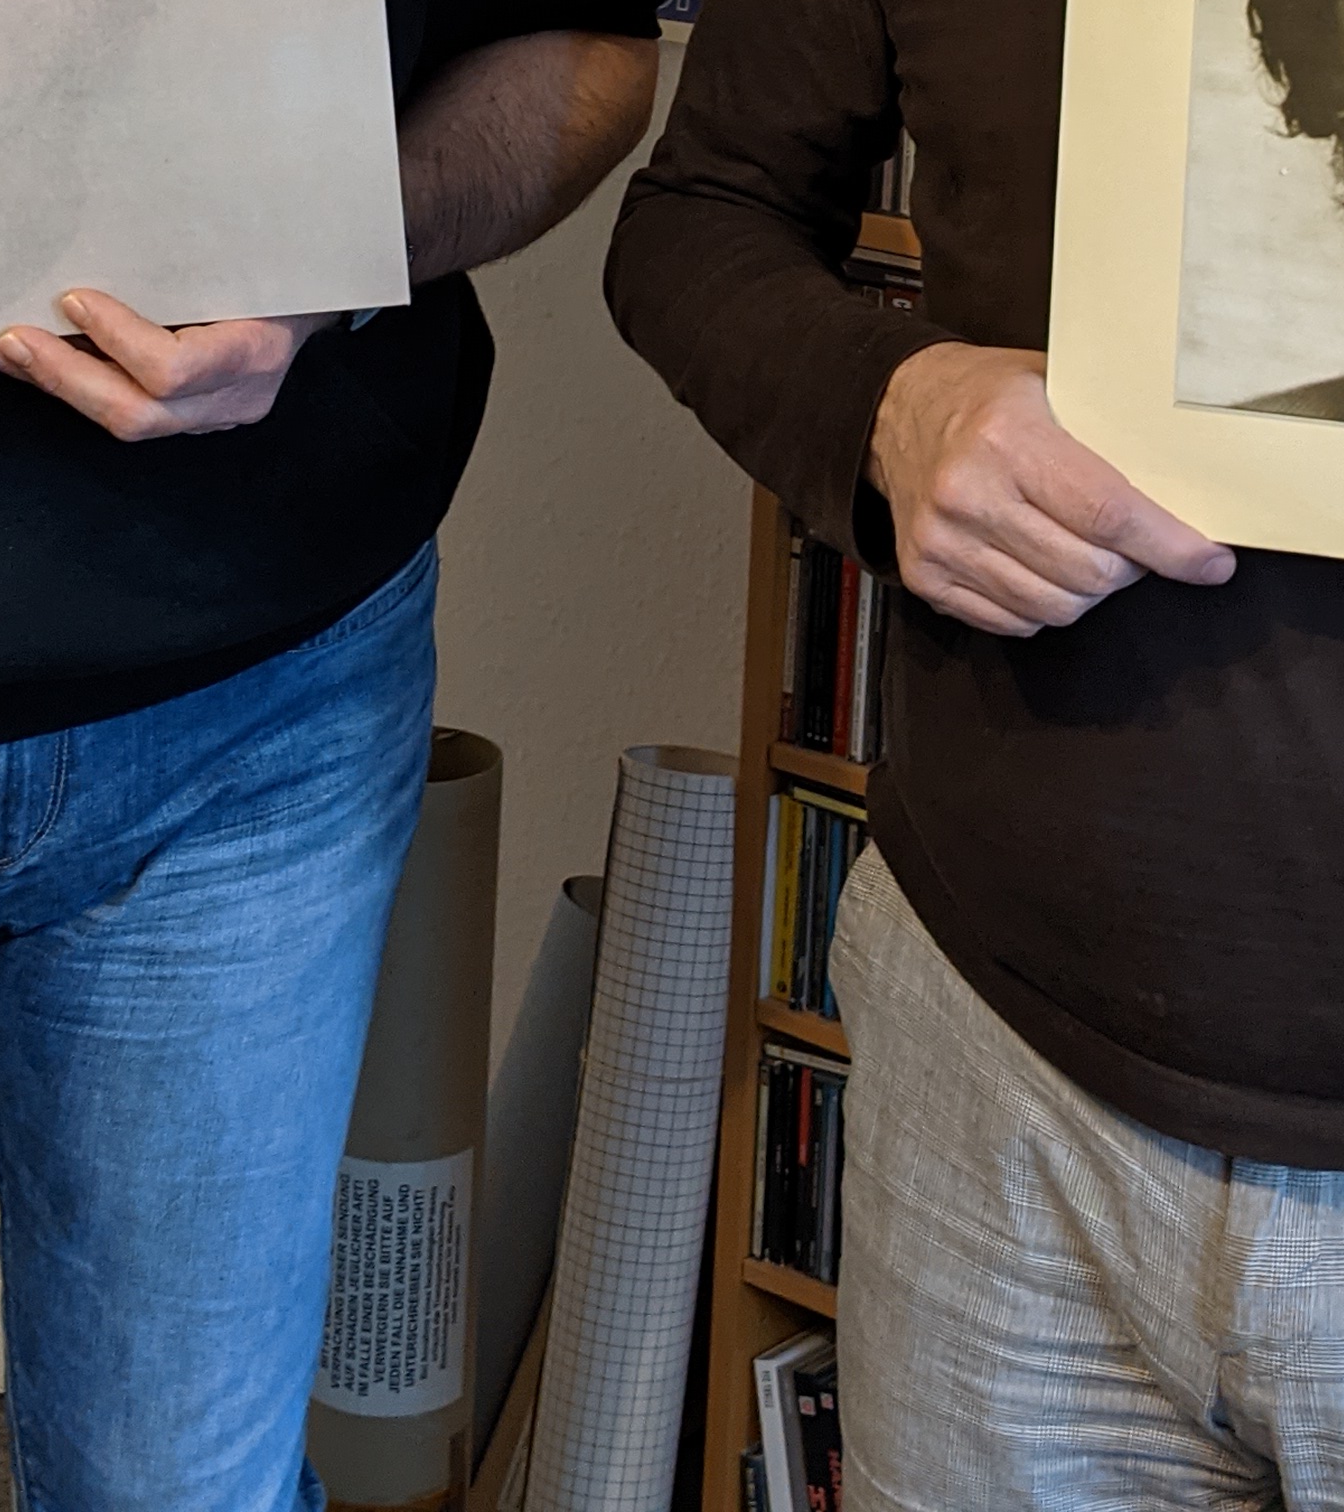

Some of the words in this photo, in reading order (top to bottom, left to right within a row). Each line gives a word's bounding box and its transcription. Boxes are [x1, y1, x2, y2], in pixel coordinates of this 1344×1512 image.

[383, 1196, 395, 1223] AUF
[398, 1185, 411, 1214] UND
[380, 1227, 394, 1264] BITTE
[394, 1217, 409, 1285] ANNAHME
[411, 1239, 422, 1259] SIE
[378, 1270, 390, 1289] SIE
[363, 1293, 374, 1333] EINER
[393, 1289, 405, 1311] DIE
[373, 1294, 390, 1384] VERWEIGERN
[391, 1315, 403, 1347] FALL
[358, 1339, 371, 1378] FALLE
[389, 1350, 402, 1394] JEDEN
